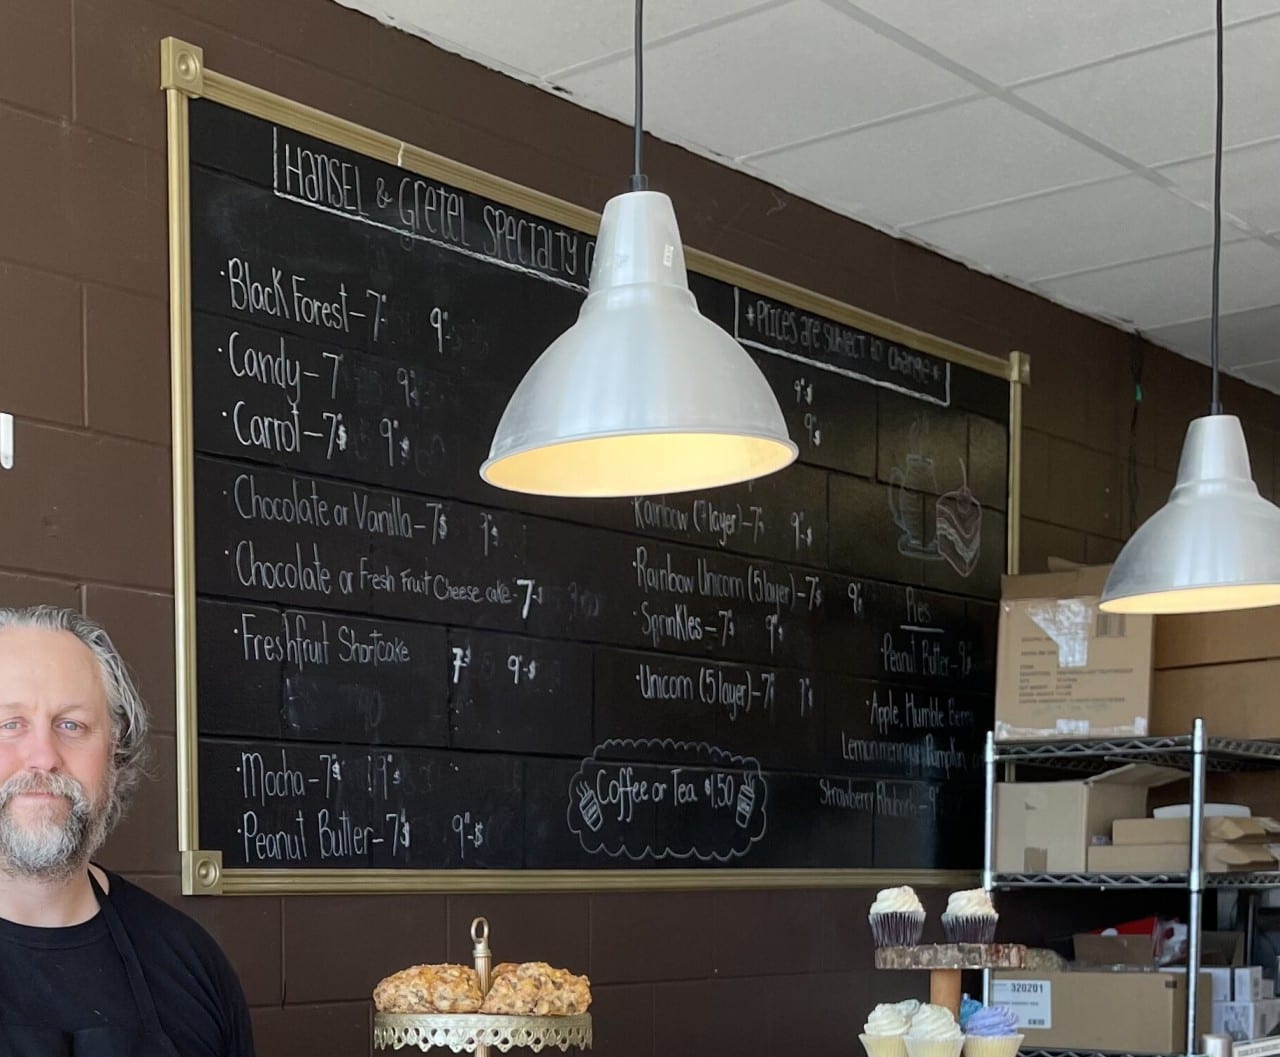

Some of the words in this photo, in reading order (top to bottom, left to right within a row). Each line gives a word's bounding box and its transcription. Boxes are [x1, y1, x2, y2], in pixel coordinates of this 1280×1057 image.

[291, 274, 350, 333] Forest
[227, 330, 302, 405] Candy
[232, 400, 302, 453] Carrot
[233, 473, 330, 528] Chocolate
[333, 503, 349, 527] or
[352, 490, 413, 539] Vanilla
[235, 539, 332, 595] Chocolate
[338, 569, 354, 595] or
[359, 556, 396, 593] Fresh
[399, 567, 433, 596] Fruit
[432, 573, 483, 604] Cheese
[637, 545, 695, 594] Rainbow
[697, 557, 745, 601] Unicorn
[336, 624, 412, 667] Shortcake
[641, 600, 704, 648] Sprinkles
[882, 631, 918, 674] Peanut
[639, 663, 694, 701] Unicorn
[905, 691, 946, 729] Humble
[241, 748, 306, 808] Mocha
[595, 765, 649, 823] Coffee
[651, 784, 668, 804] or
[670, 767, 699, 808] Tea
[704, 772, 735, 809] $1.50
[241, 808, 308, 864] Peanut
[316, 807, 375, 861] Butter
